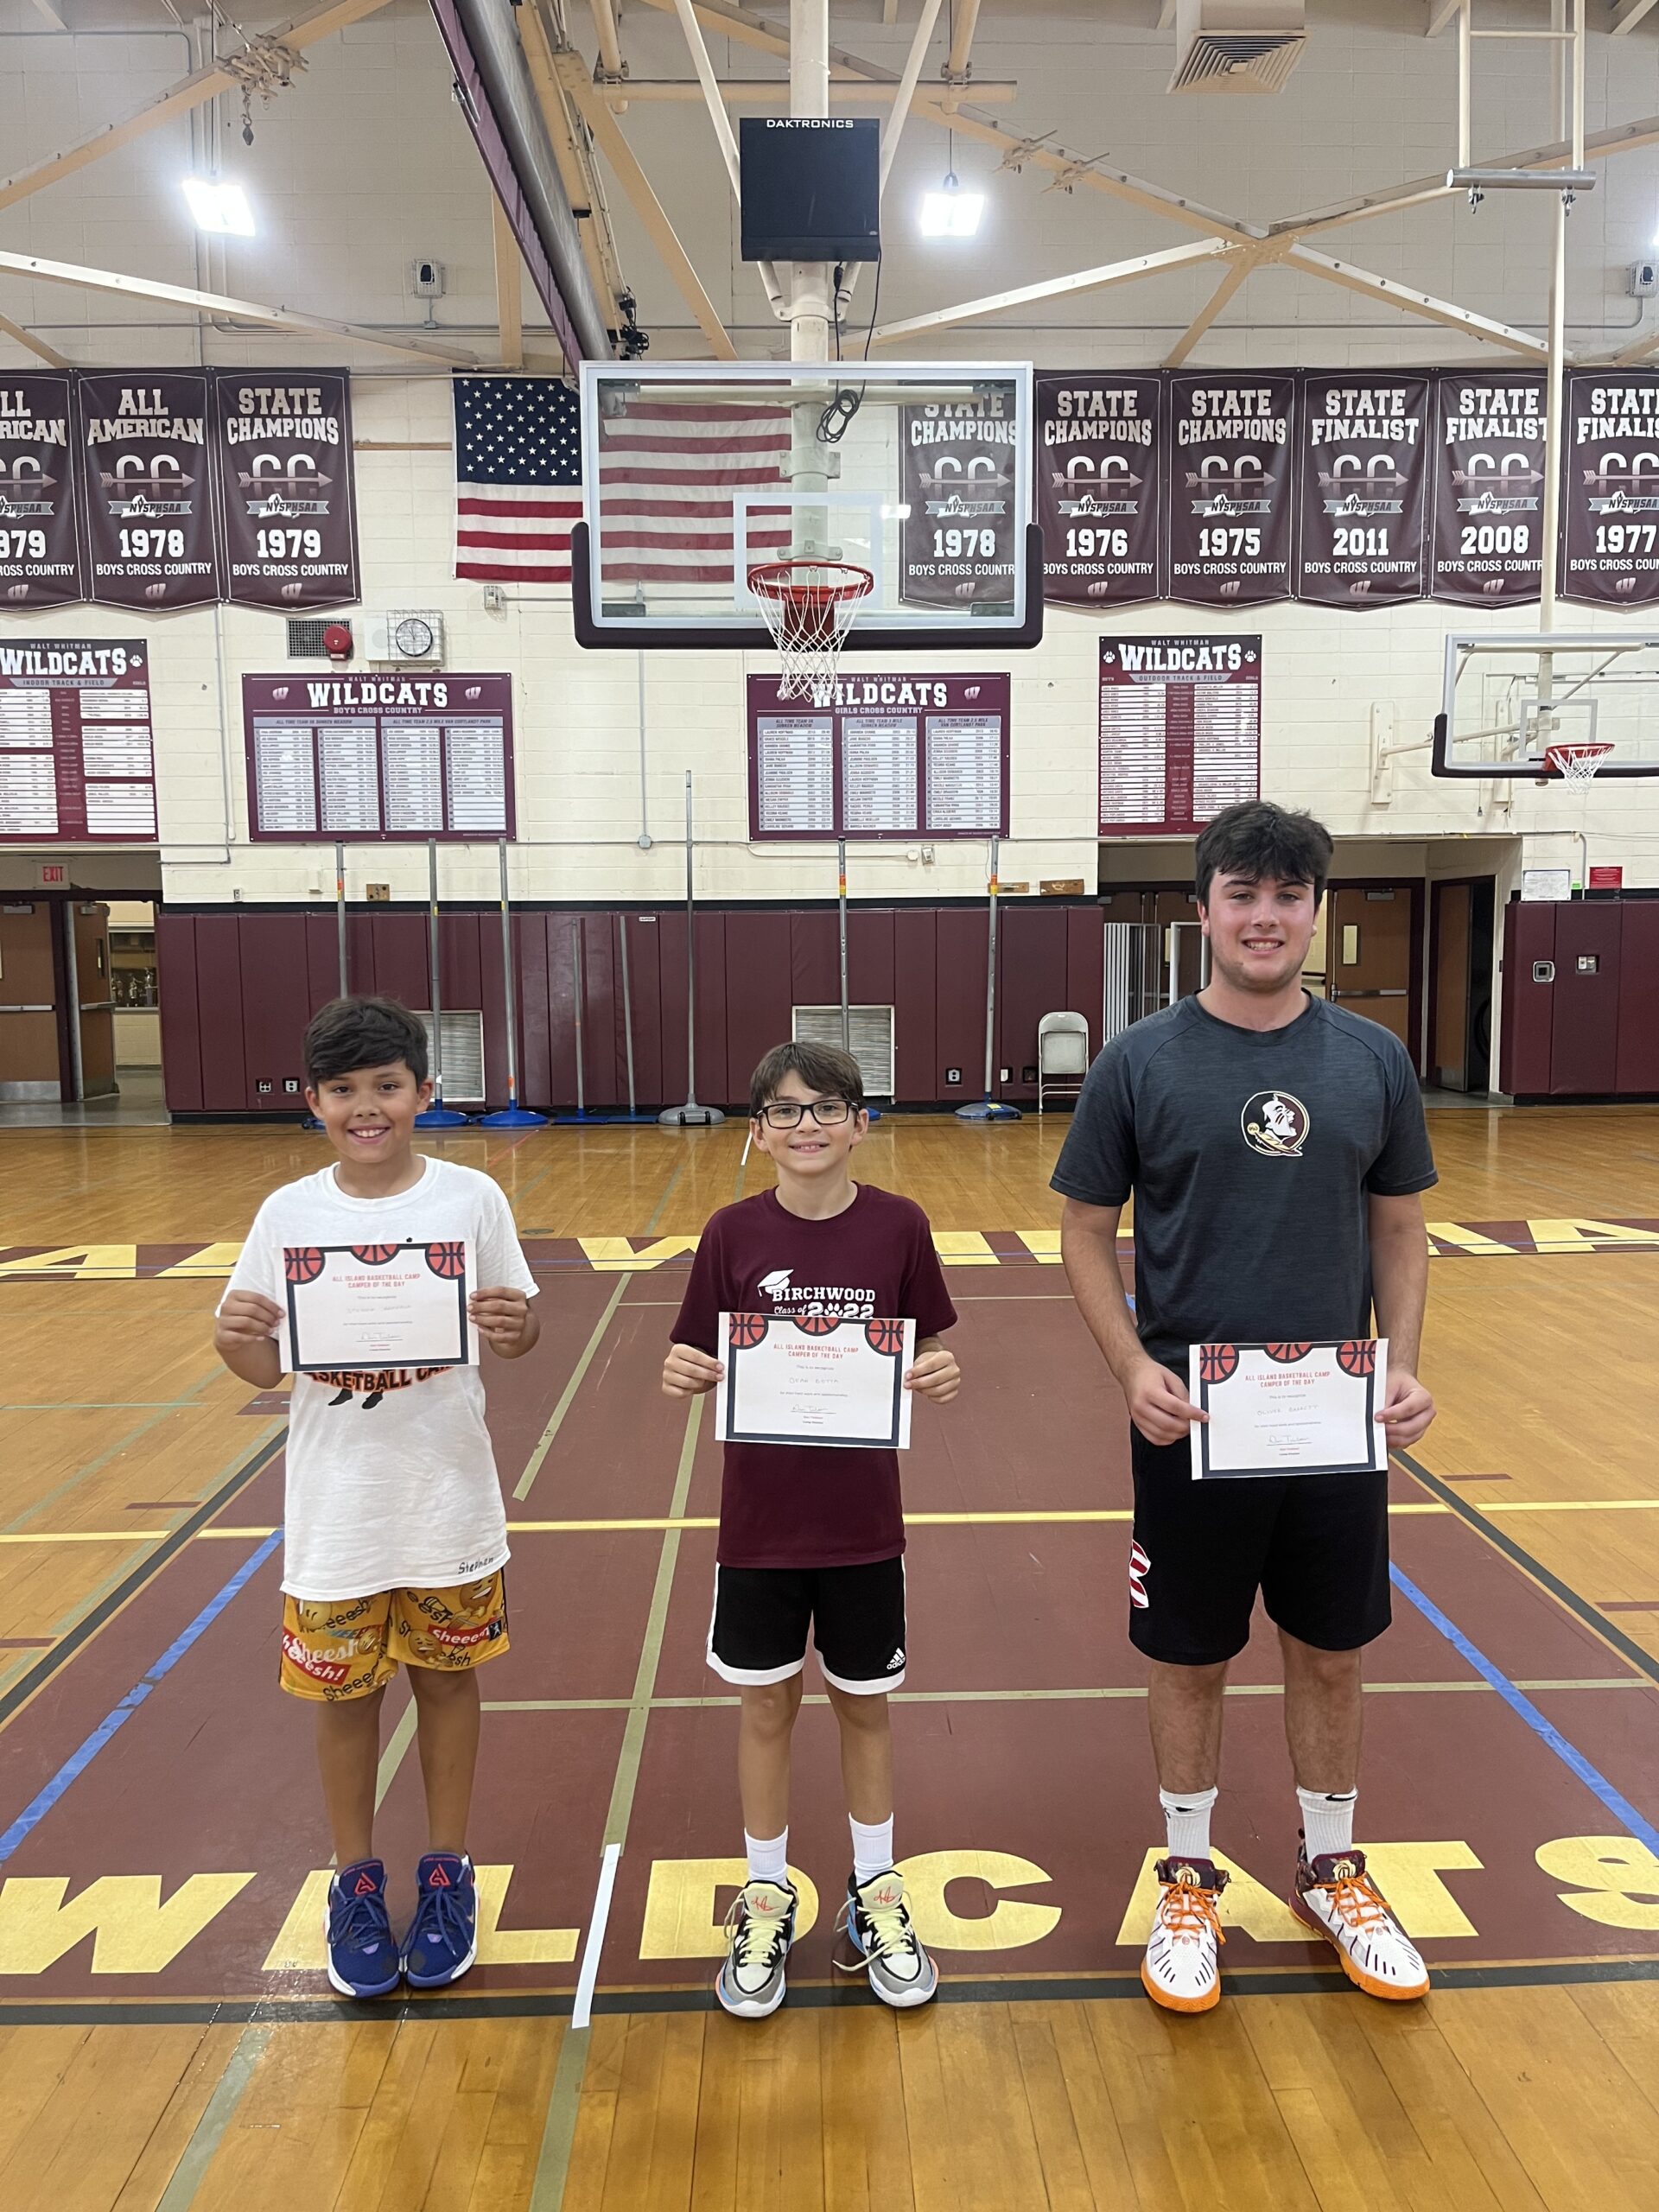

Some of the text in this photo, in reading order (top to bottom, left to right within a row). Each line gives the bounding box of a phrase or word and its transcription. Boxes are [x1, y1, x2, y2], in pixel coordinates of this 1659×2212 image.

[766, 119, 854, 128] DAKTRONICS
[0, 391, 31, 417] LL
[118, 389, 168, 416] ALL
[239, 388, 321, 414] STATE
[1058, 390, 1137, 416] STATE
[1192, 390, 1271, 416] STATE
[1325, 390, 1406, 416] STATE
[1459, 389, 1539, 415] STATE
[1592, 388, 1659, 414] STAT
[0, 419, 67, 447] RICAN
[87, 418, 204, 445] AMERICAN
[227, 417, 339, 445] CHAMPIONS
[1045, 419, 1152, 446] CHAMPIONS
[1178, 418, 1287, 446] CHAMPIONS
[1312, 418, 1419, 446] FINALIST
[1577, 417, 1659, 444] FINALI
[0, 531, 47, 558] 979
[120, 530, 184, 557] 1978
[257, 529, 321, 557] 1979
[933, 529, 995, 557] 1978
[1066, 529, 1128, 557] 1976
[1199, 528, 1261, 556] 1975
[1333, 529, 1389, 556] 2011
[1461, 525, 1529, 555] 2008
[1596, 525, 1656, 553] 1977
[26, 564, 74, 575] COUNTRY
[96, 563, 212, 575] BOYS CROSS COUNTRY
[232, 563, 348, 576] BOYS CROSS COUNTRY
[909, 564, 1014, 575] BOYS CROSS COUNTR
[1071, 563, 1105, 575] CROSS
[1108, 563, 1154, 574] COUNTRY
[1174, 561, 1286, 575] BOYS CROSS COUNTRY
[1305, 561, 1417, 573] BOYS CROSS COUNTRY
[1438, 560, 1542, 572] BOYS CROSS COUNTR
[1571, 560, 1597, 571] BOYS
[1599, 559, 1633, 570] CROSS
[0, 648, 126, 676] WILDCATS
[1118, 643, 1241, 671] WILDCATS
[307, 683, 448, 708] WILDCATS
[811, 683, 947, 708] WILDCATS
[43, 866, 64, 882] EXIT
[772, 1287, 875, 1301] BIRCHWOOD
[774, 1306, 795, 1314] Class
[798, 1305, 807, 1315] of
